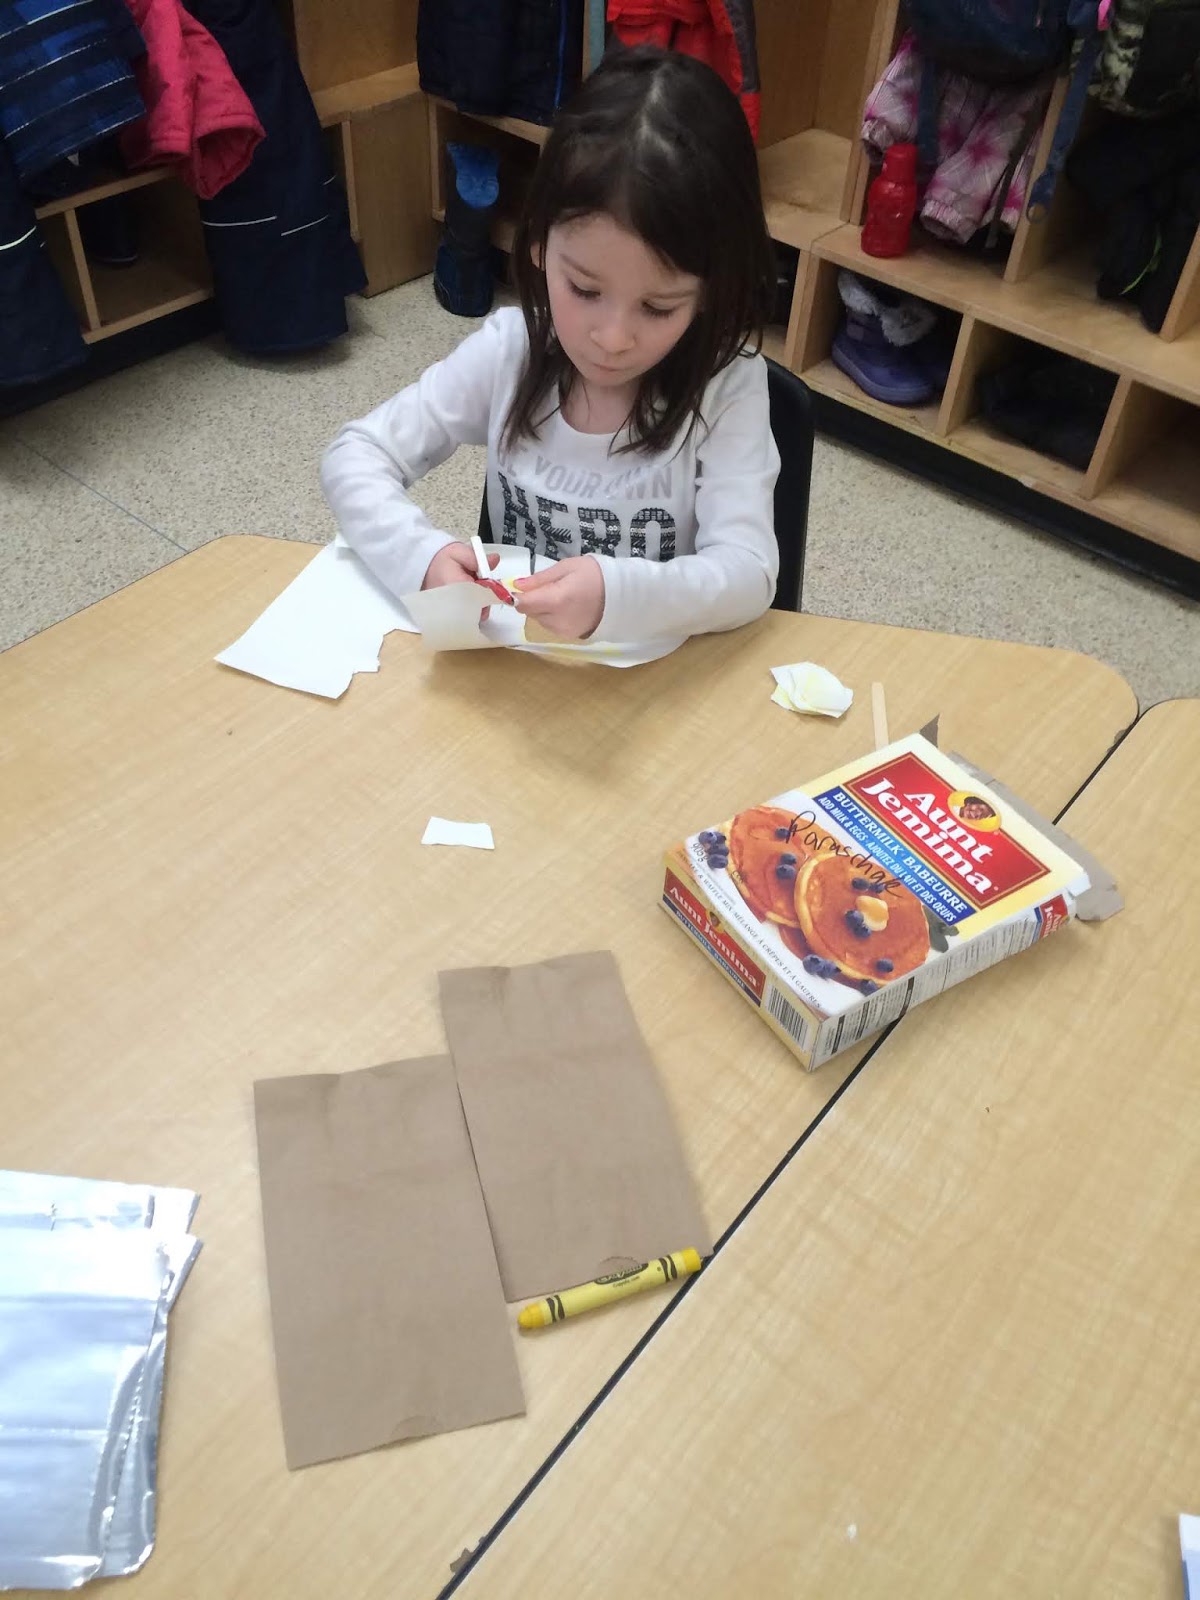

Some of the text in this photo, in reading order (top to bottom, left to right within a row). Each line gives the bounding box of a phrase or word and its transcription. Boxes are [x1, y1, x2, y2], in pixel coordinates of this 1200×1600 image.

[535, 456, 599, 499] YOUR
[498, 471, 676, 562] HERO
[818, 796, 835, 810] ADD
[830, 807, 849, 823] MILK
[844, 819, 854, 829] &
[848, 825, 869, 841] EGGS
[861, 777, 992, 894] Jemima
[903, 793, 993, 864] Aunt
[833, 791, 967, 914] BUTTERMILK BABEURRE
[865, 841, 895, 865] AJOUTEZ
[890, 863, 904, 874] DU
[911, 883, 925, 893] ET
[919, 890, 937, 904] DES
[932, 901, 957, 922] OEUFS
[669, 886, 703, 926] Aunt
[703, 920, 757, 987] Jemima
